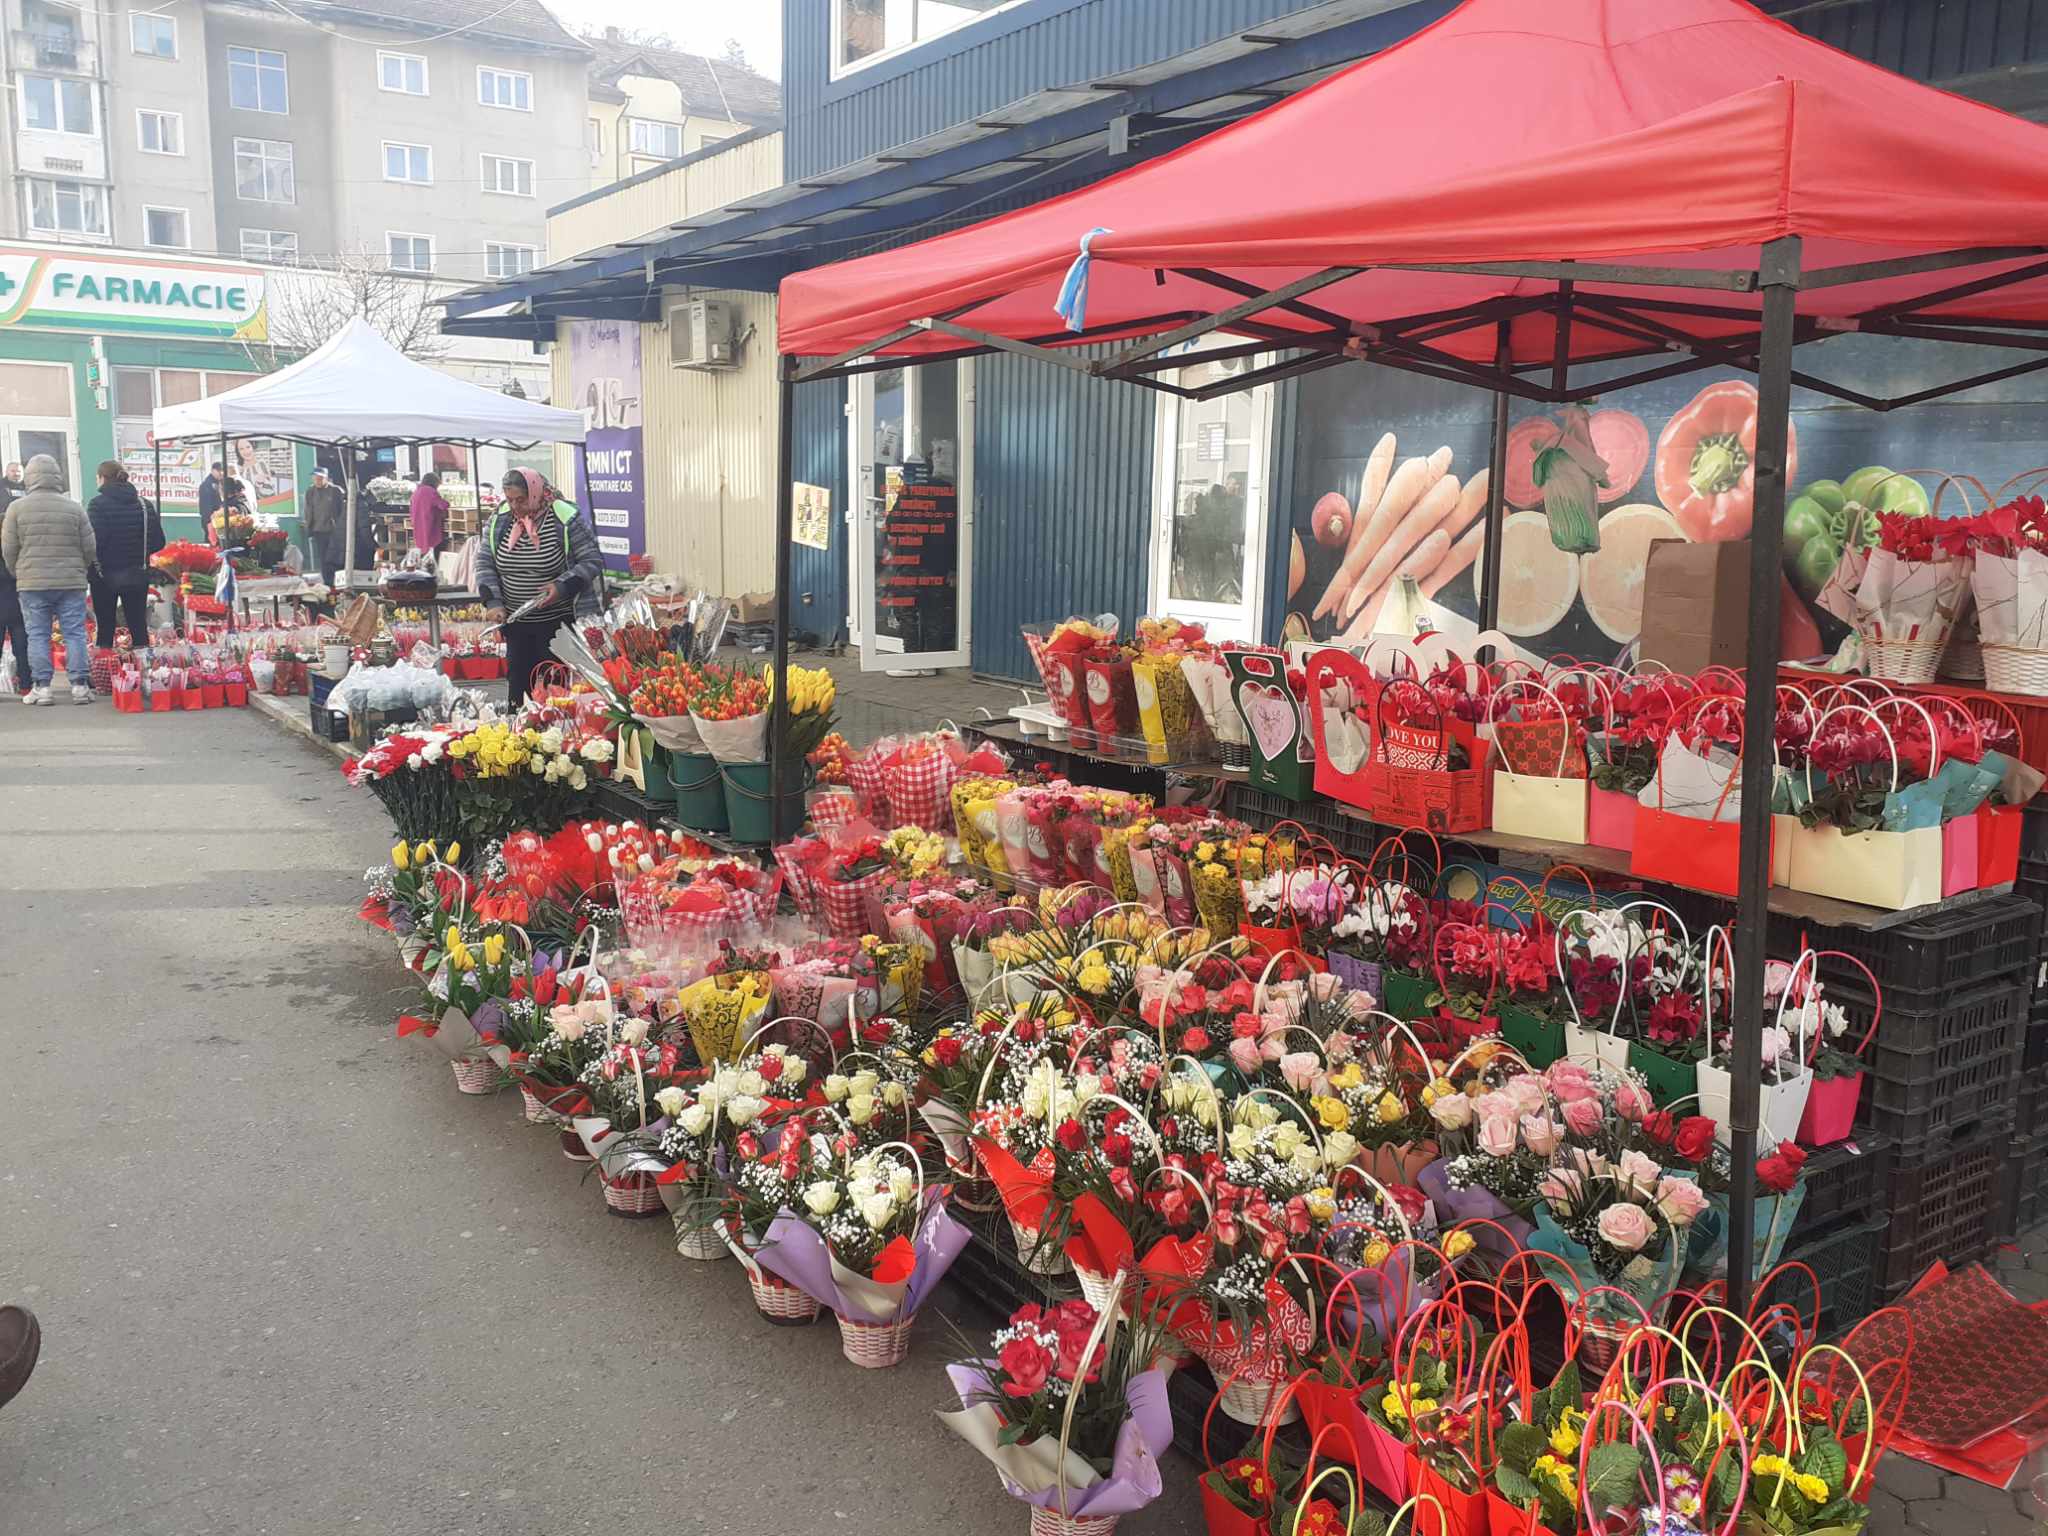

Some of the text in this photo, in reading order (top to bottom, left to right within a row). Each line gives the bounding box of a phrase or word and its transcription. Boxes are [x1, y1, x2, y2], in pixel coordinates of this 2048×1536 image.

[52, 272, 246, 312] FARMACIE
[585, 480, 632, 492] ECONTARE CAS
